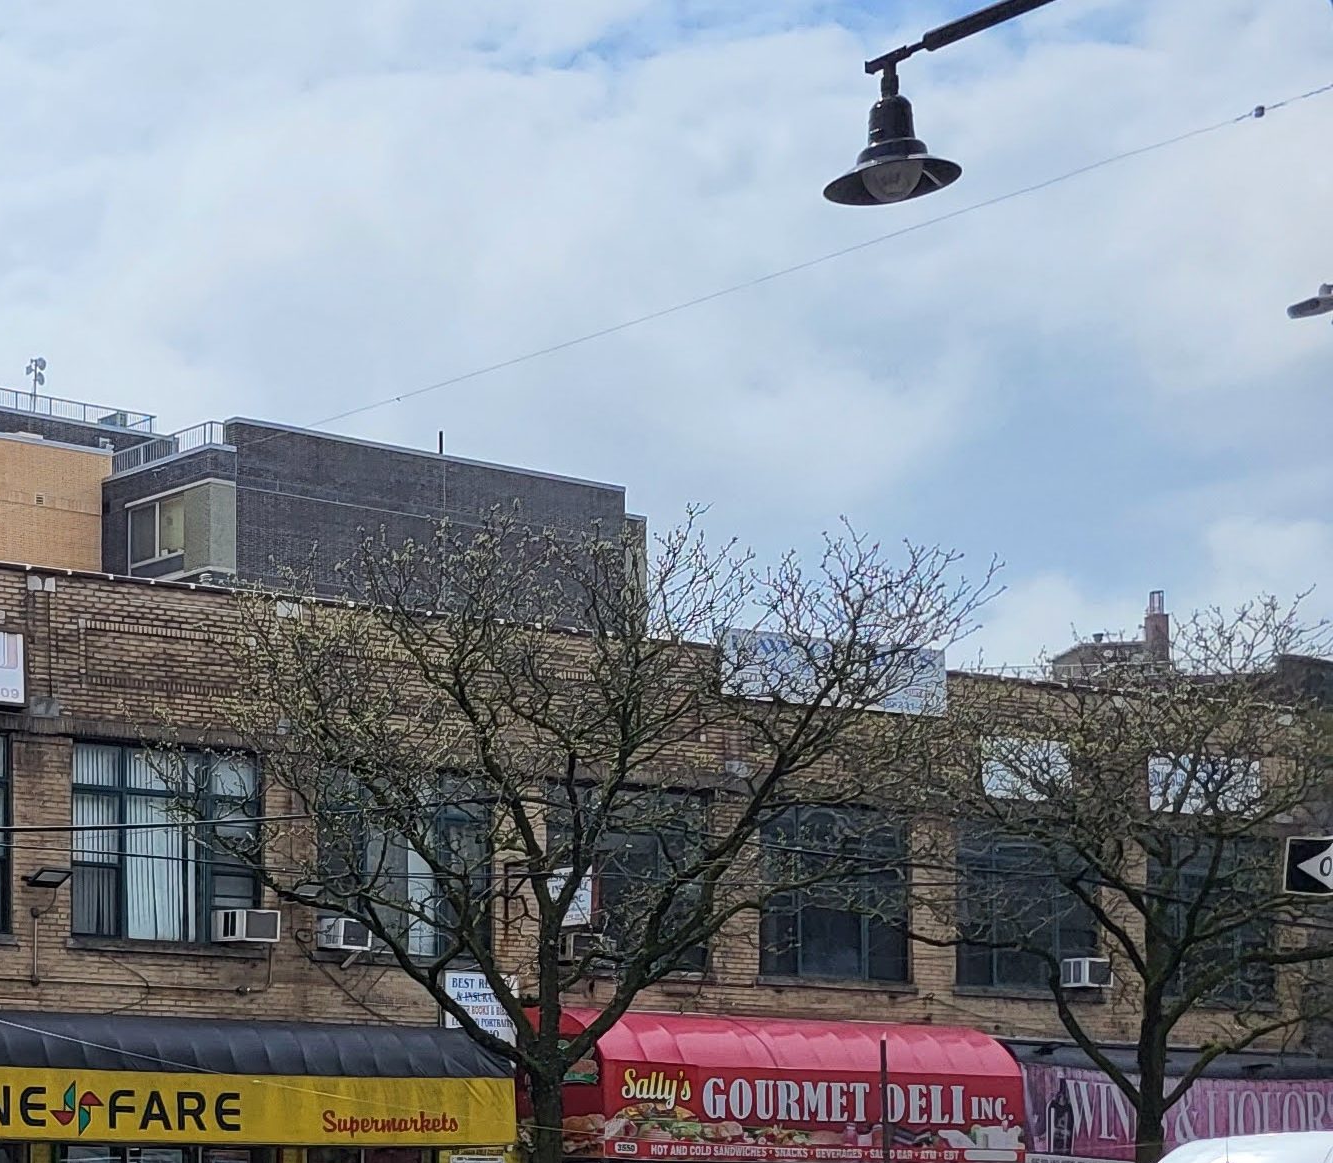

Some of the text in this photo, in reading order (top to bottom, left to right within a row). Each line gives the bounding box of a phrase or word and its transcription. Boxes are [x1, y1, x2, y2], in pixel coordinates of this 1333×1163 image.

[452, 977, 475, 989] BEST
[108, 1089, 241, 1132] FARE
[621, 1069, 1015, 1124] Sally's GOURMET DELI INC.
[321, 1110, 460, 1138] Supermarkets
[1174, 1087, 1200, 1144] &
[650, 1144, 668, 1155] HOT
[670, 1145, 688, 1156] AND
[689, 1145, 712, 1156] COLD
[713, 1146, 767, 1158] SANDWICHES
[774, 1147, 808, 1158] SNACKS
[815, 1149, 863, 1159] BEVERAGES
[870, 1149, 894, 1160] SALD
[896, 1150, 912, 1160] BAR
[920, 1150, 937, 1160] ATM
[943, 1151, 959, 1160] EBT
